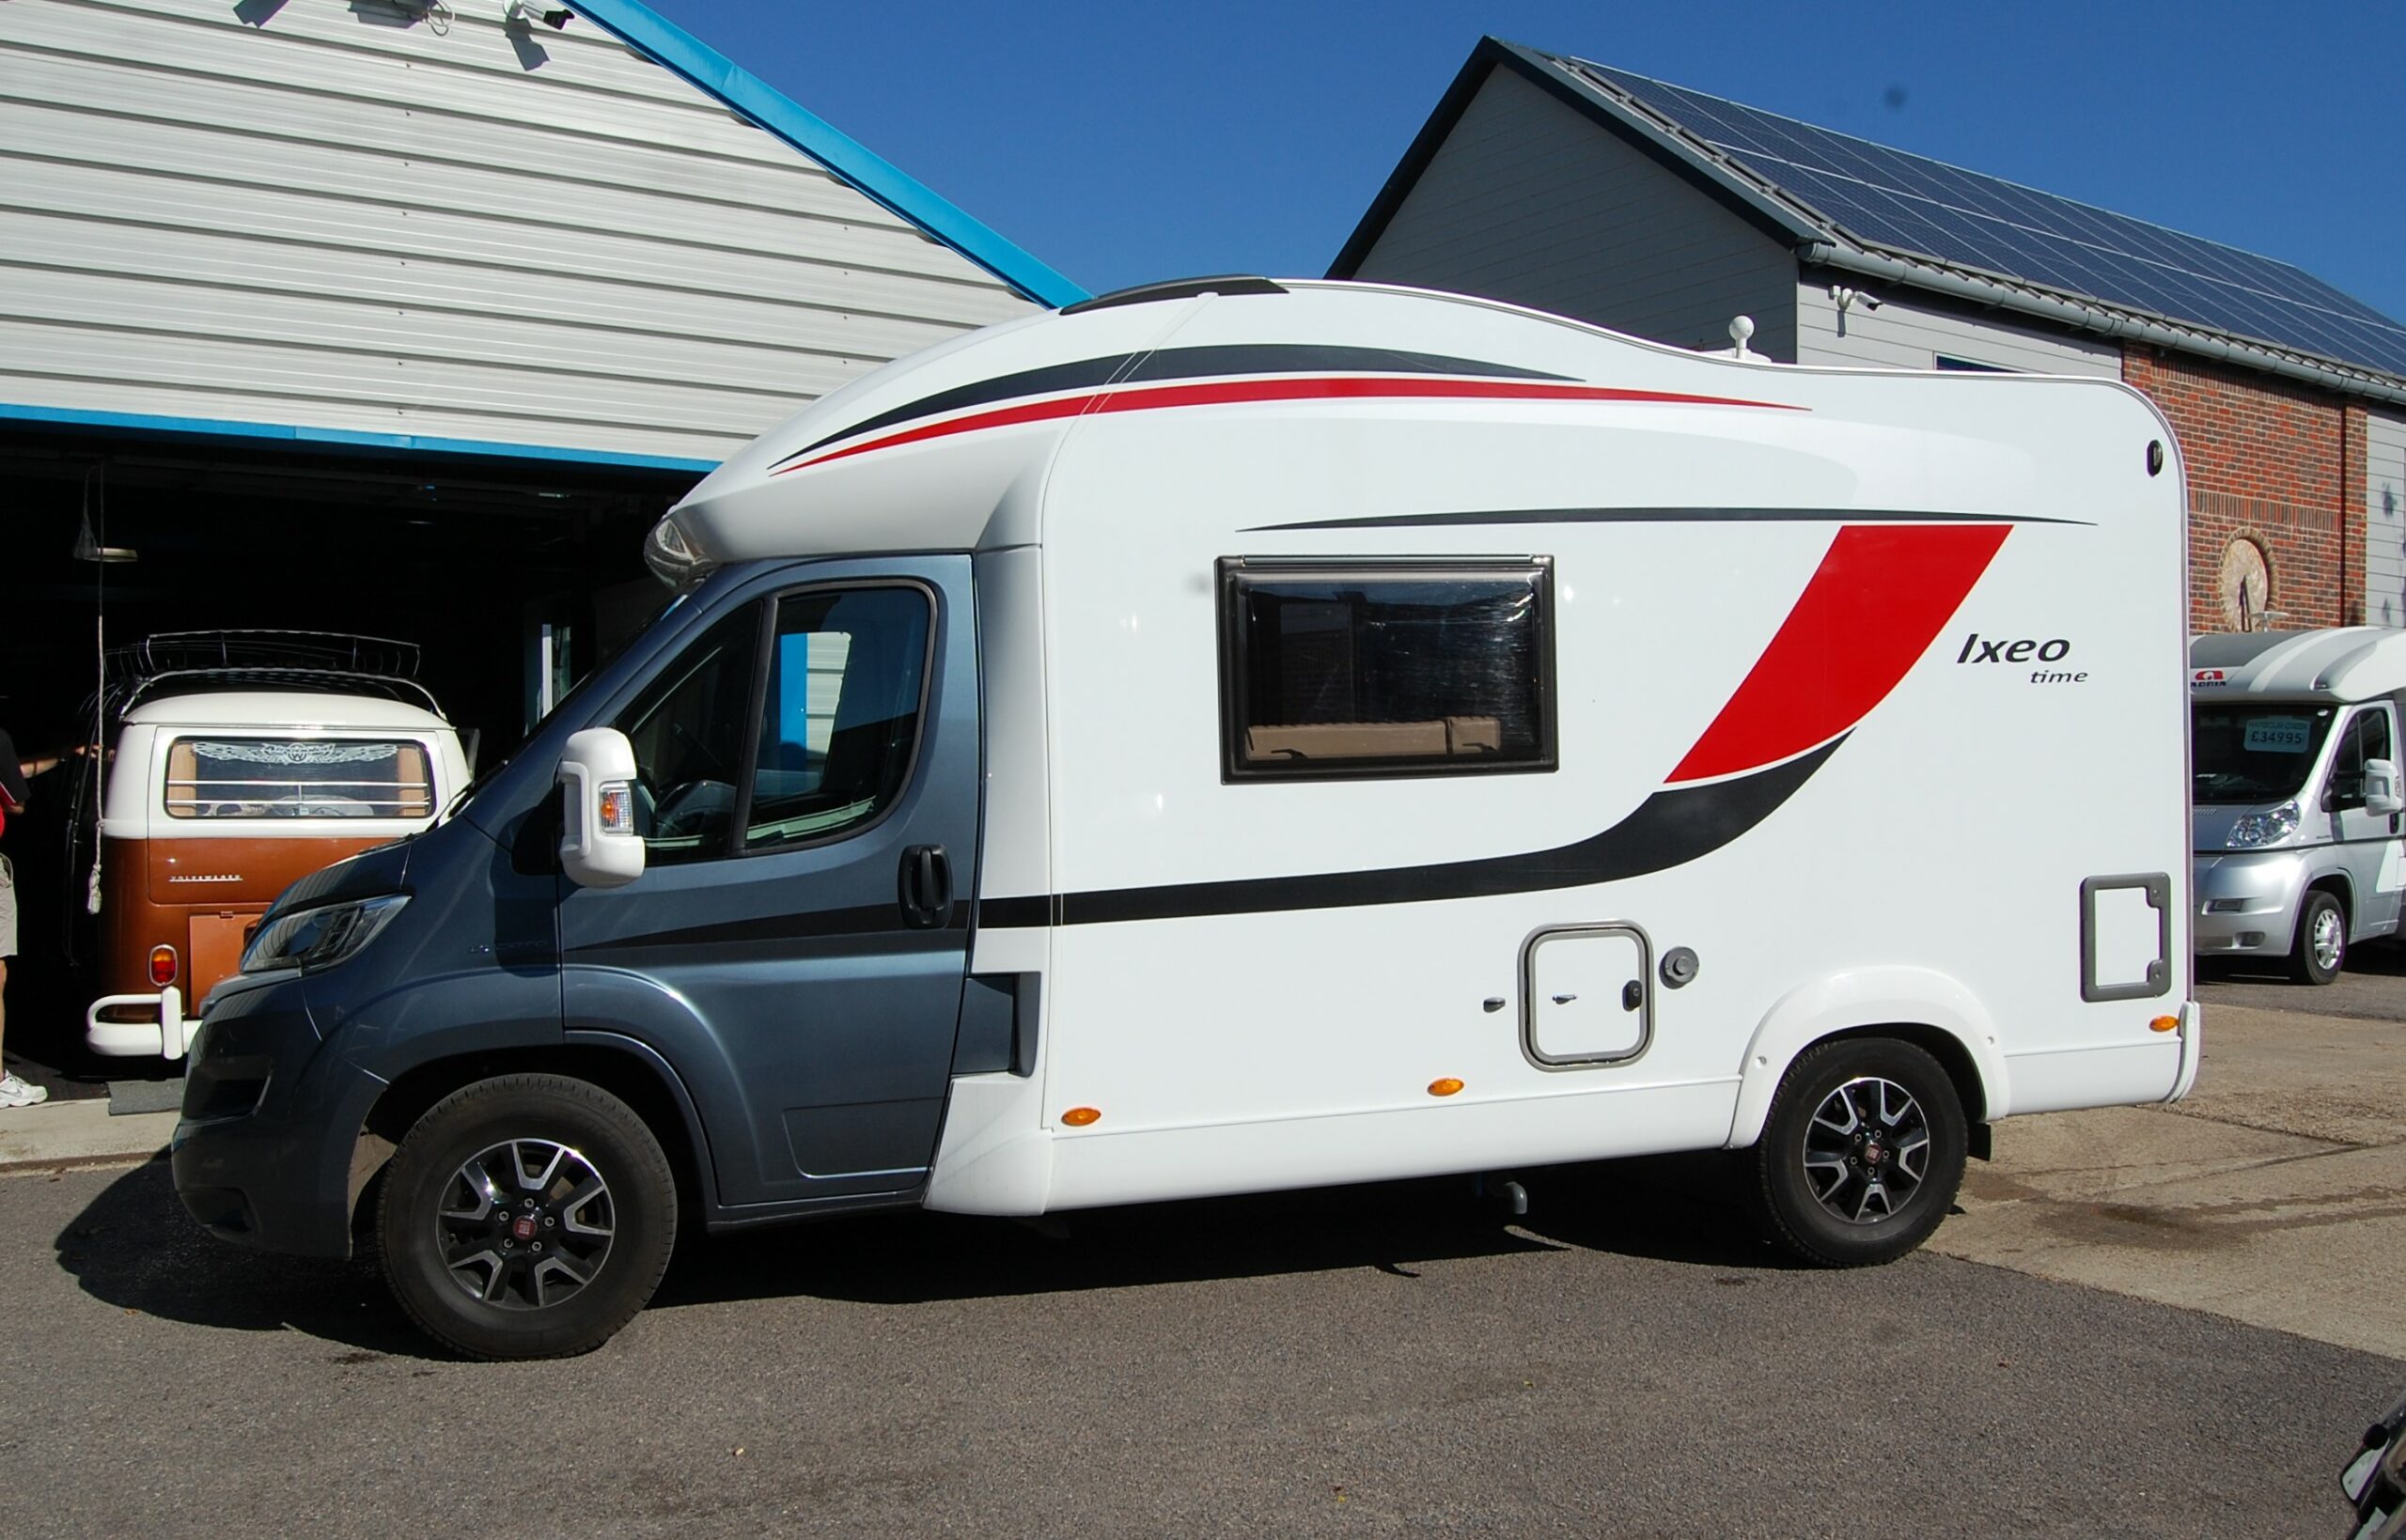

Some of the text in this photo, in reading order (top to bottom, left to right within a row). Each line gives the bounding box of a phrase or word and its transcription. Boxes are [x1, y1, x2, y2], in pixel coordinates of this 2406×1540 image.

[1957, 633, 2070, 663] Ixeo
[2030, 670, 2088, 683] time
[2251, 731, 2302, 744] £34995
